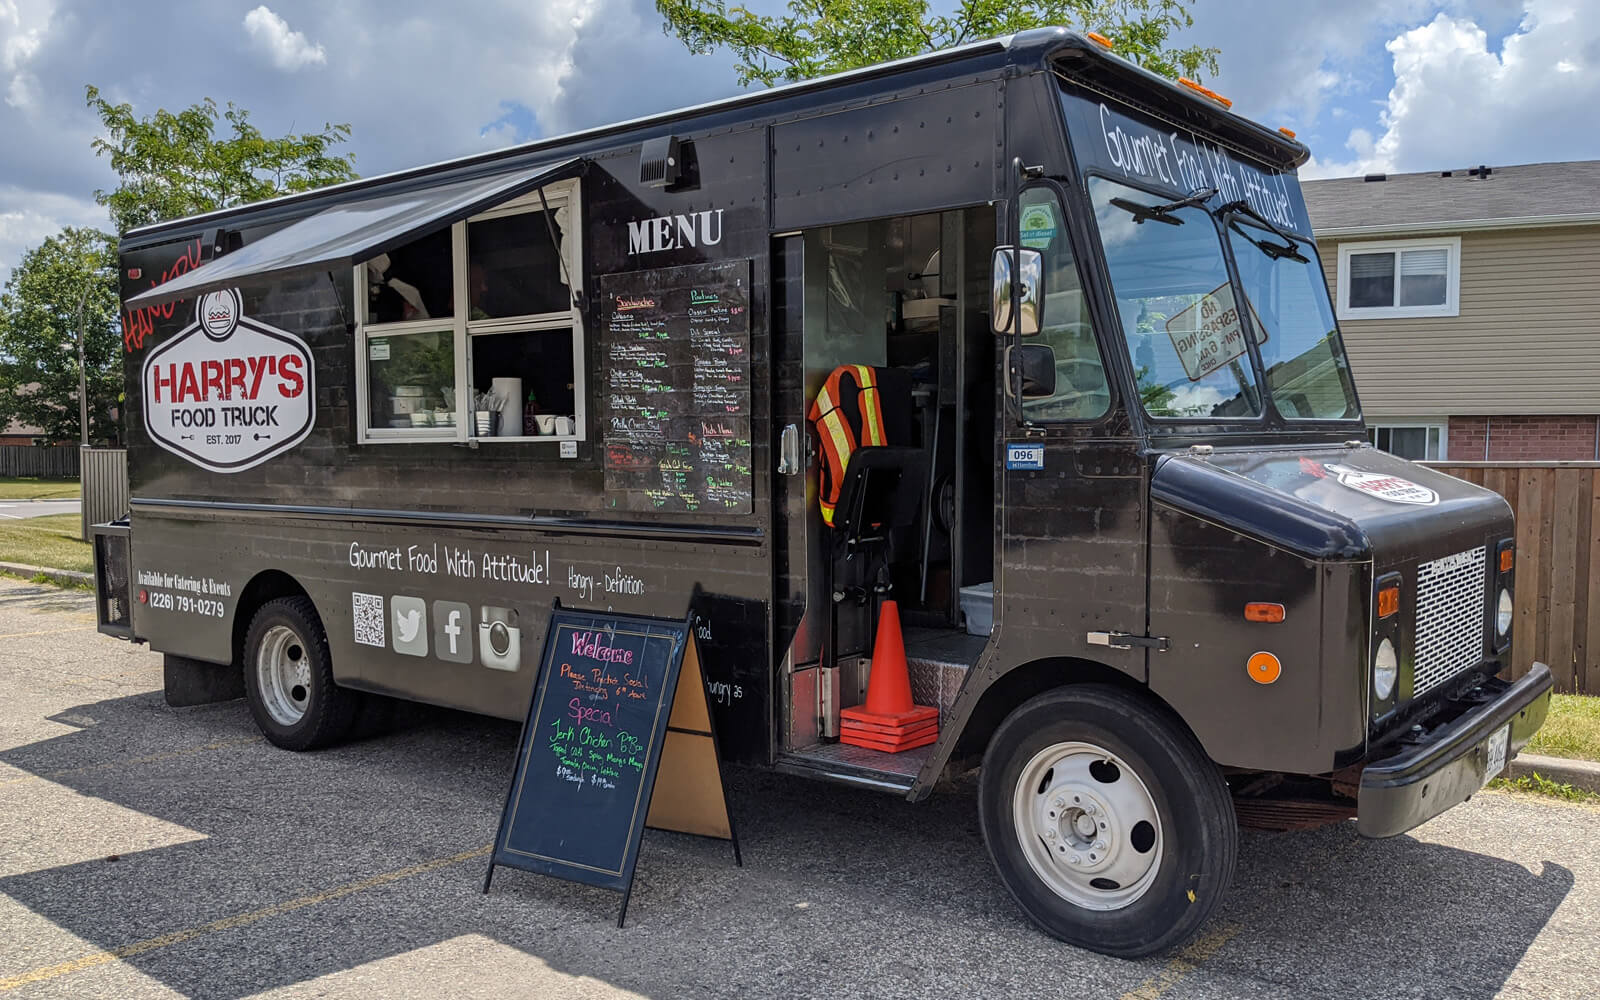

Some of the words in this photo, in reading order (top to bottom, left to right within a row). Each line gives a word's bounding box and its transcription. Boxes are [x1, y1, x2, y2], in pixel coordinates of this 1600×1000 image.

[1100, 103, 1170, 184] Gourmet
[1170, 132, 1208, 192] Food
[1203, 141, 1242, 204] With
[1239, 164, 1298, 231] Attitude!
[626, 208, 724, 255] MENU
[153, 354, 304, 404] HARRY'S
[171, 407, 216, 428] FOOD
[221, 404, 280, 428] TRUCK
[206, 435, 224, 445] EST.
[225, 434, 242, 445] 2017
[1013, 450, 1034, 460] 096
[349, 541, 402, 571] Gourmet
[408, 543, 438, 574] Food
[445, 546, 476, 579] With
[482, 550, 550, 585] Attitude!
[138, 570, 163, 587] Available
[164, 573, 173, 588] for
[174, 574, 201, 596] Catering
[202, 577, 209, 593] &
[209, 578, 231, 597] Events
[568, 565, 594, 601] Hangry
[605, 566, 645, 596] Definition:
[150, 591, 174, 611] (226)
[176, 595, 224, 618] 791-0279
[571, 631, 633, 665] Welcome
[560, 663, 586, 681] Please
[624, 672, 648, 689] Social
[706, 675, 731, 707] ungry
[733, 684, 743, 698] as
[568, 697, 620, 726] Special
[549, 718, 575, 743] Jerk
[580, 726, 613, 748] Chicken
